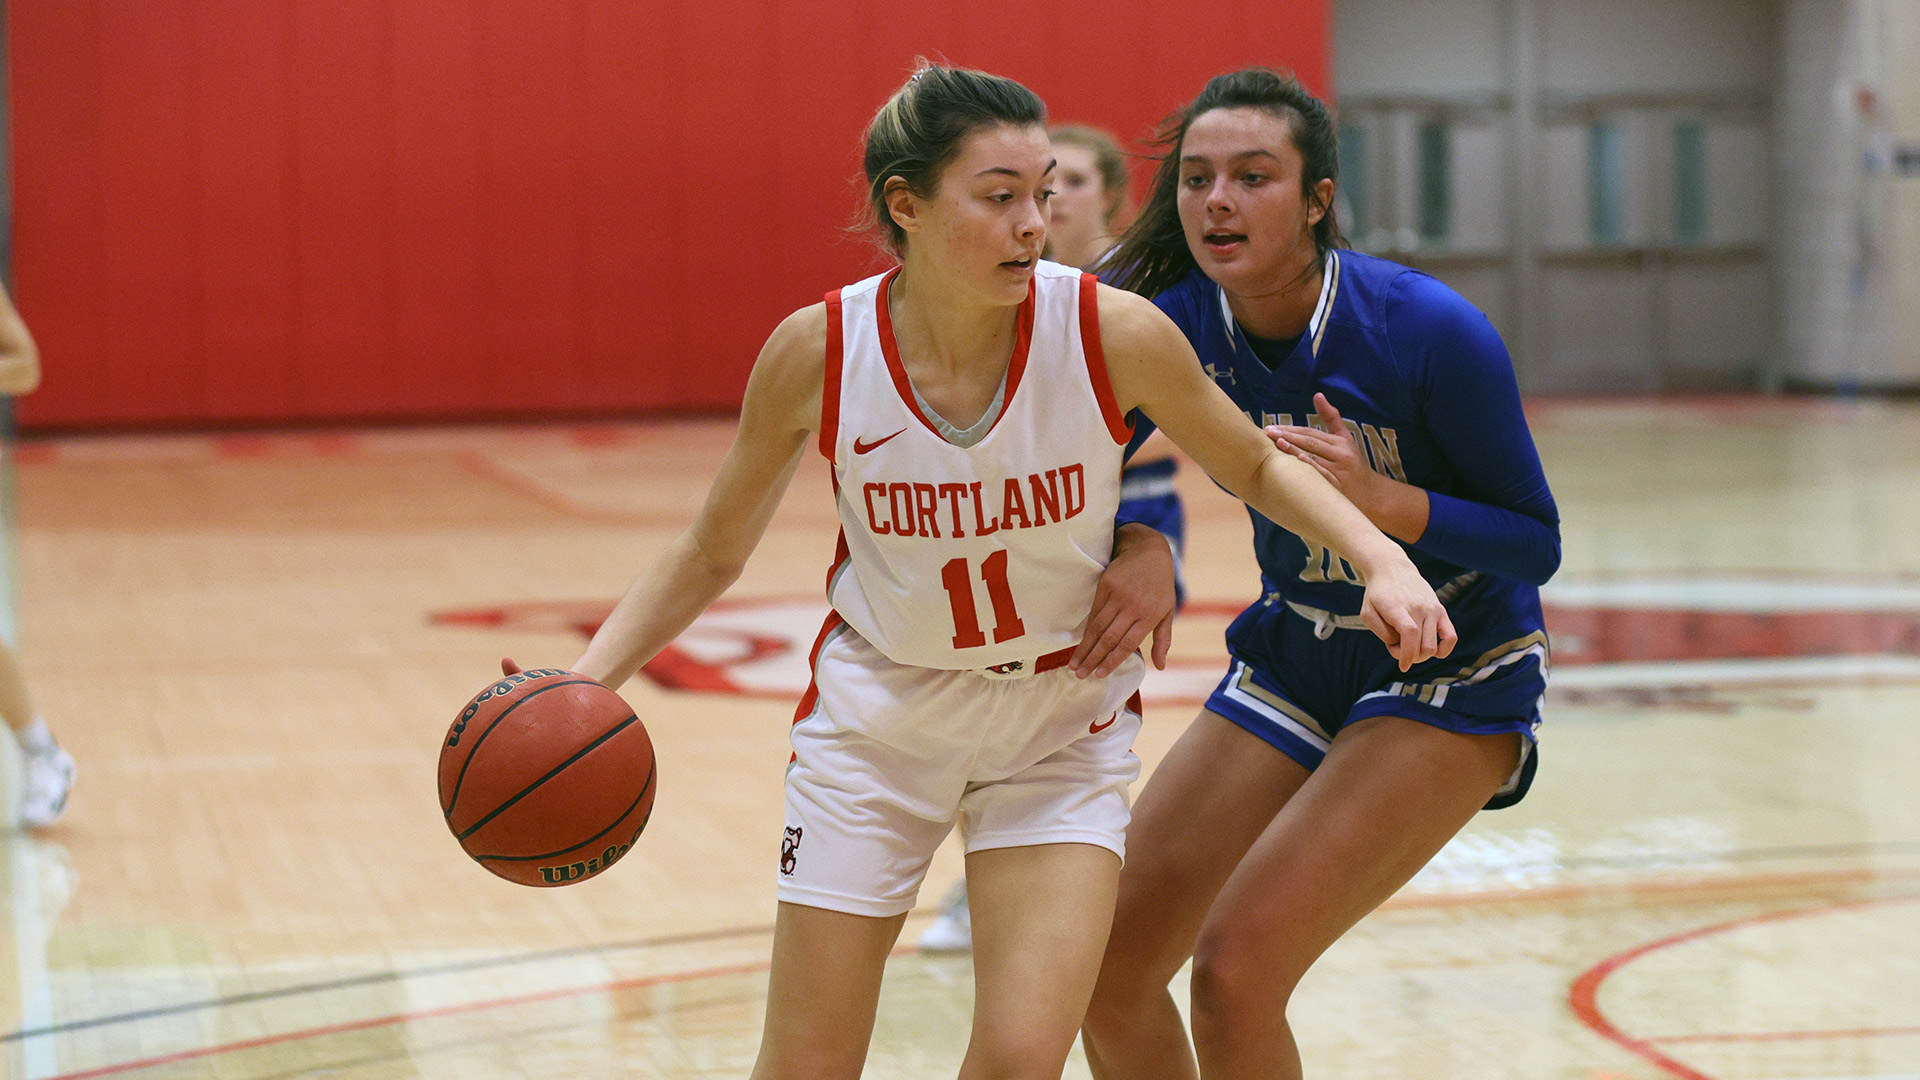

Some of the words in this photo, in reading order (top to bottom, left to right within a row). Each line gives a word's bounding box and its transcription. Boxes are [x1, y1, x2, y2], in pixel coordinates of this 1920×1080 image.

[863, 463, 1086, 538] CORTLAND
[941, 549, 1025, 649] 11
[447, 668, 573, 748] Wilson
